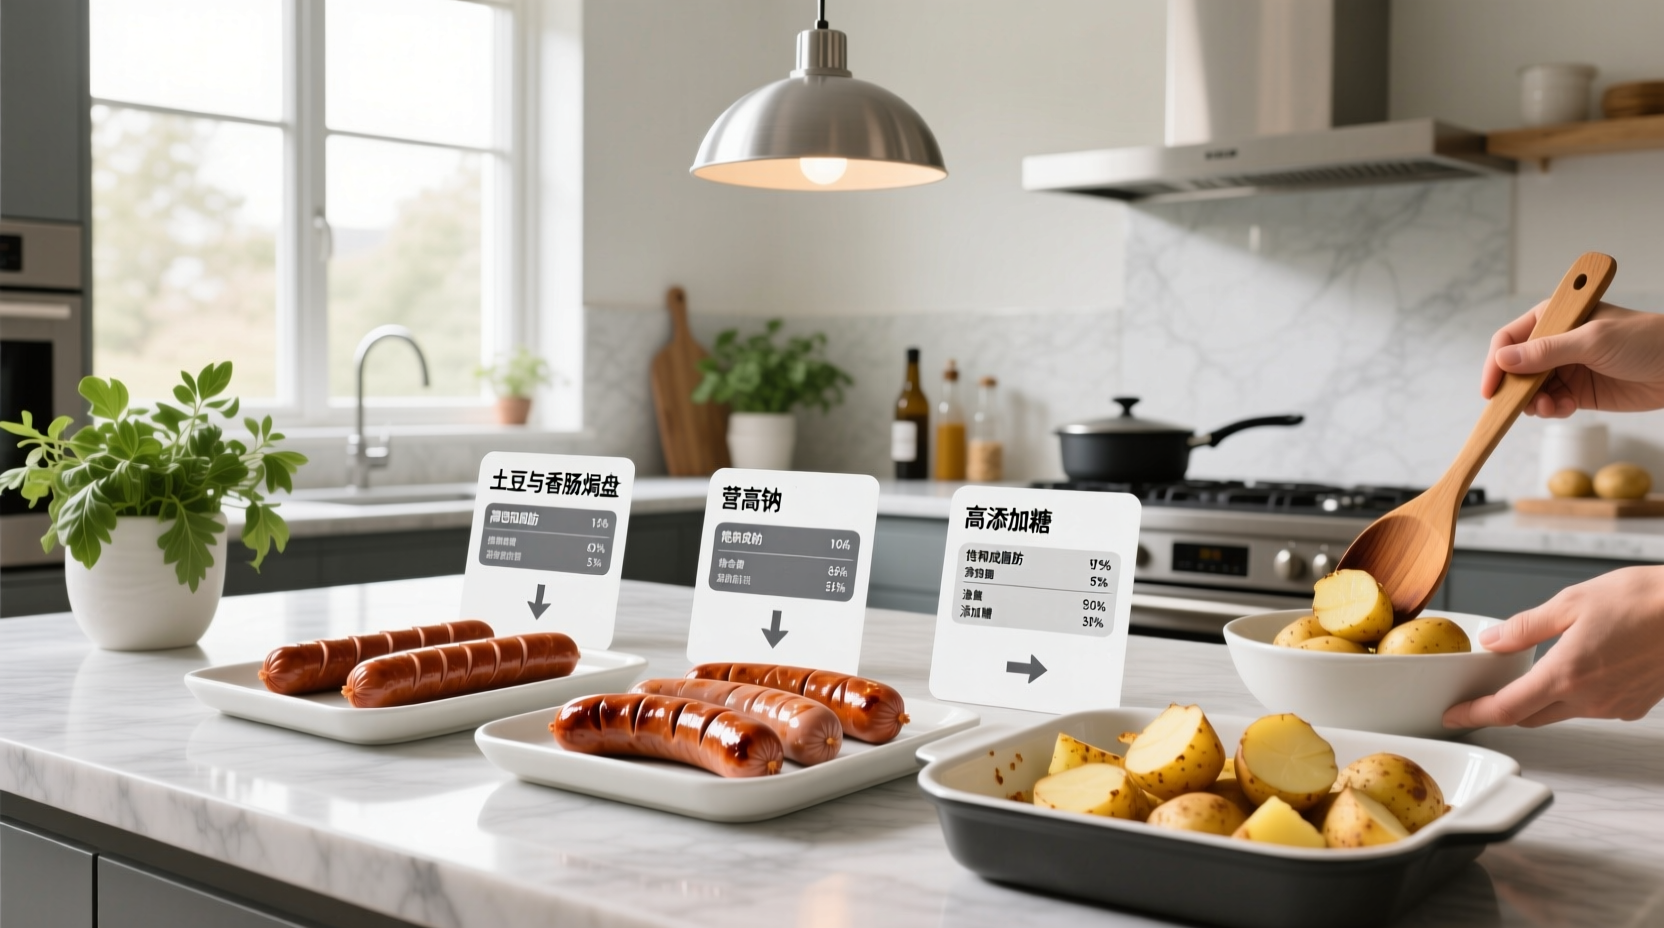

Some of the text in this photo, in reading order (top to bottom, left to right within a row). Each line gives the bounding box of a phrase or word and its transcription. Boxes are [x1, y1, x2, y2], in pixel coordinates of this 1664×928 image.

[722, 485, 782, 513] 营高钠
[965, 505, 1052, 534] 高添加糖
